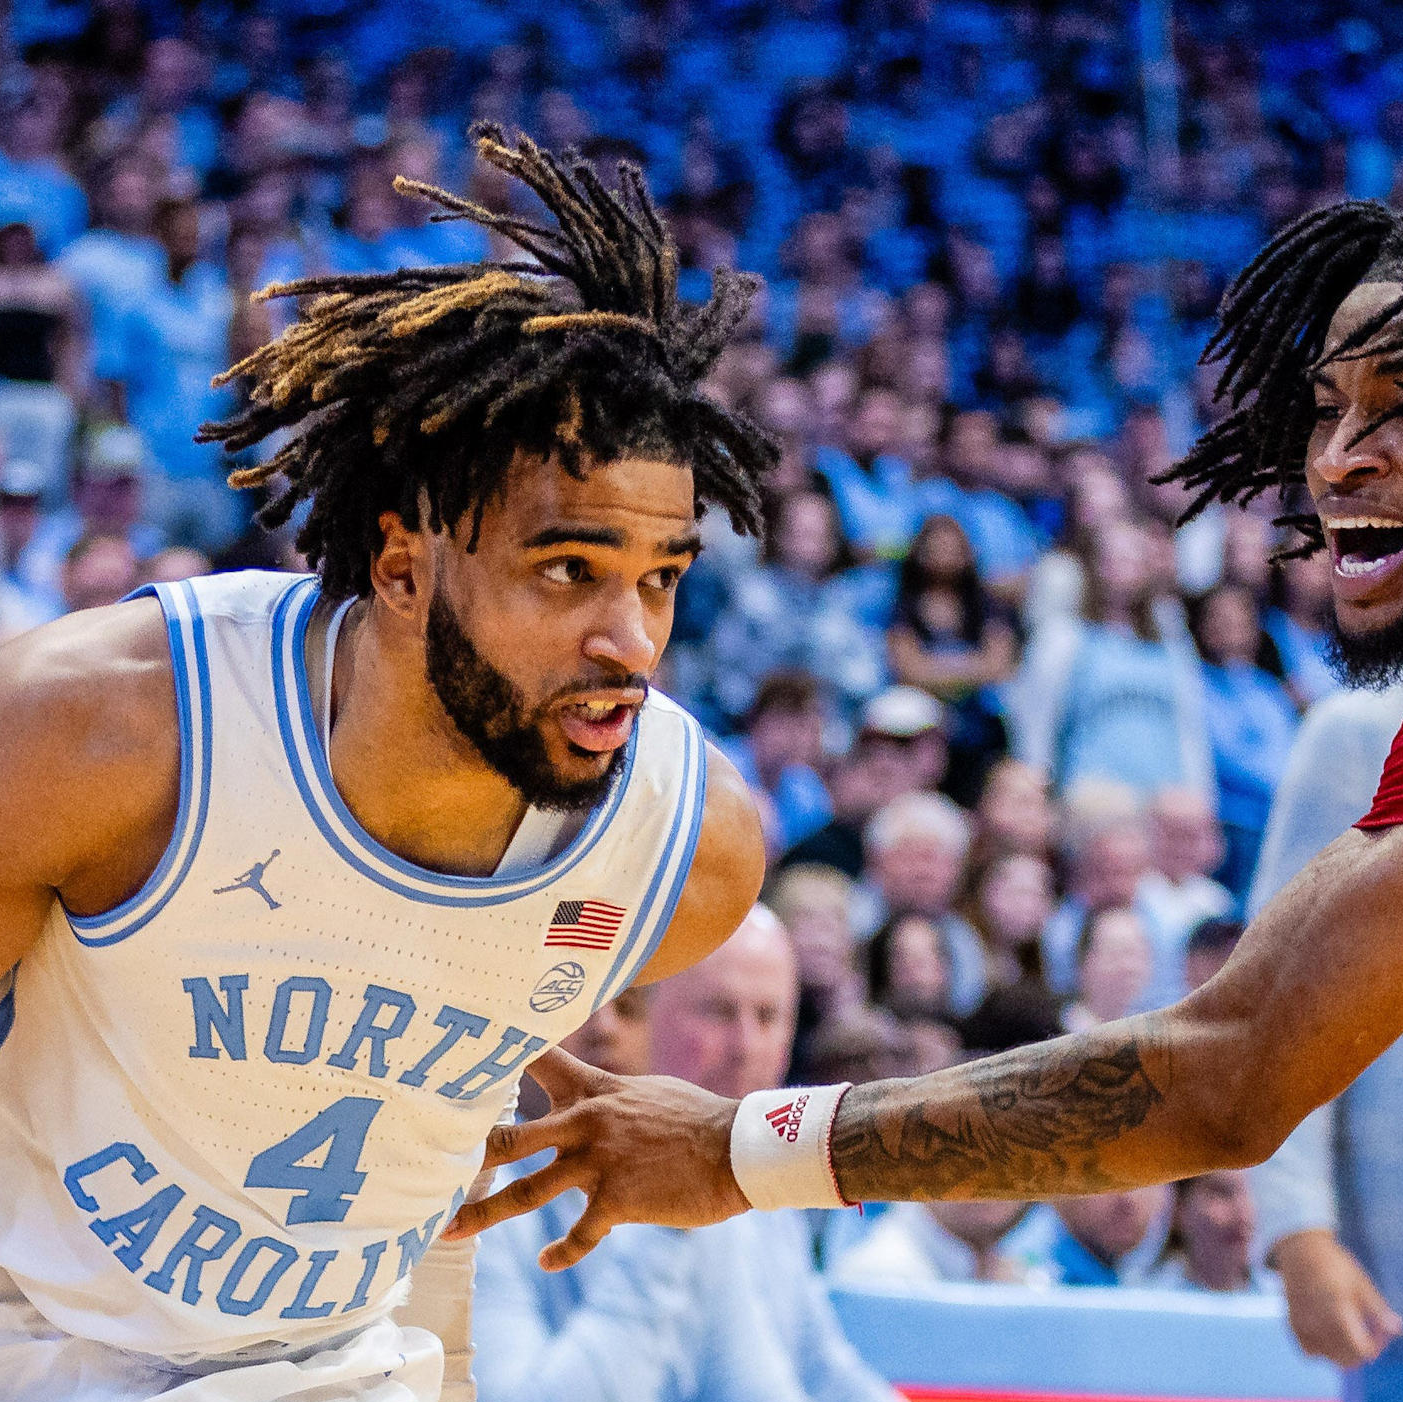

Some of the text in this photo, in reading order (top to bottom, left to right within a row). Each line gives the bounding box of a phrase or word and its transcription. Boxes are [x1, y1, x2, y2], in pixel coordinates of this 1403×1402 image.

[181, 972, 549, 1102] NORTH
[538, 979, 584, 992] ACC
[243, 1096, 383, 1226] 4
[786, 1094, 811, 1143] adidas
[63, 1141, 465, 1320] CAROLIN
